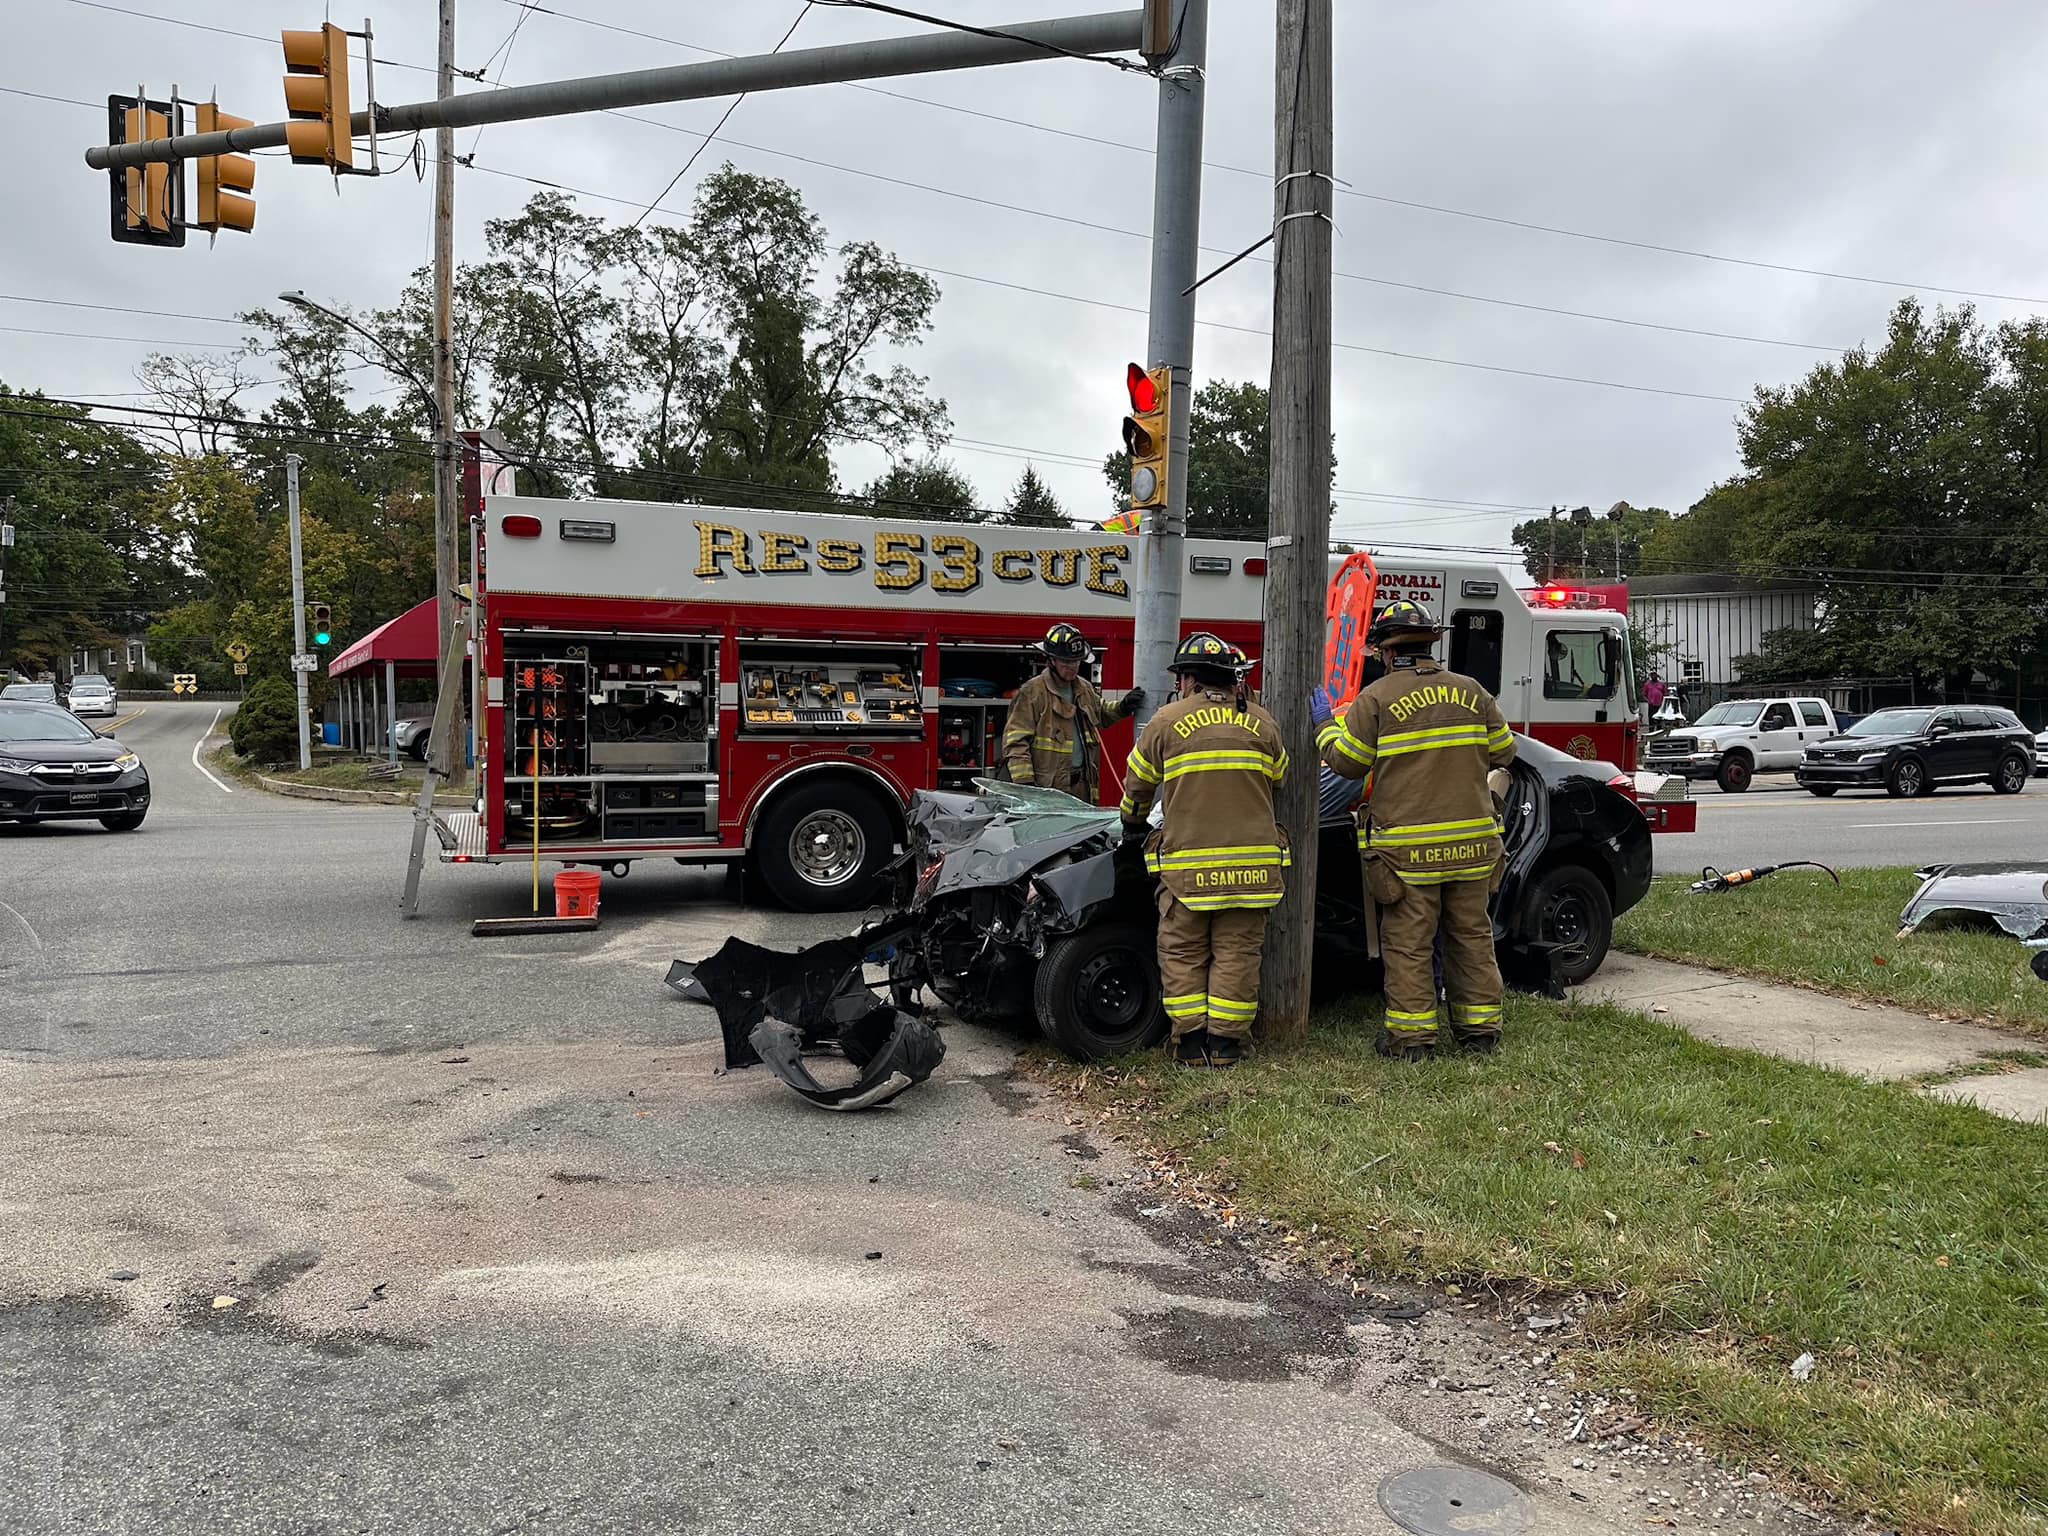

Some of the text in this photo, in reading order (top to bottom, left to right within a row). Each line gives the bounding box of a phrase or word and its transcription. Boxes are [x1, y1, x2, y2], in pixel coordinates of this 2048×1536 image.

[1408, 591, 1434, 602] CO.
[1388, 686, 1479, 722] BROOMALL
[1173, 707, 1260, 739] BROOMALL
